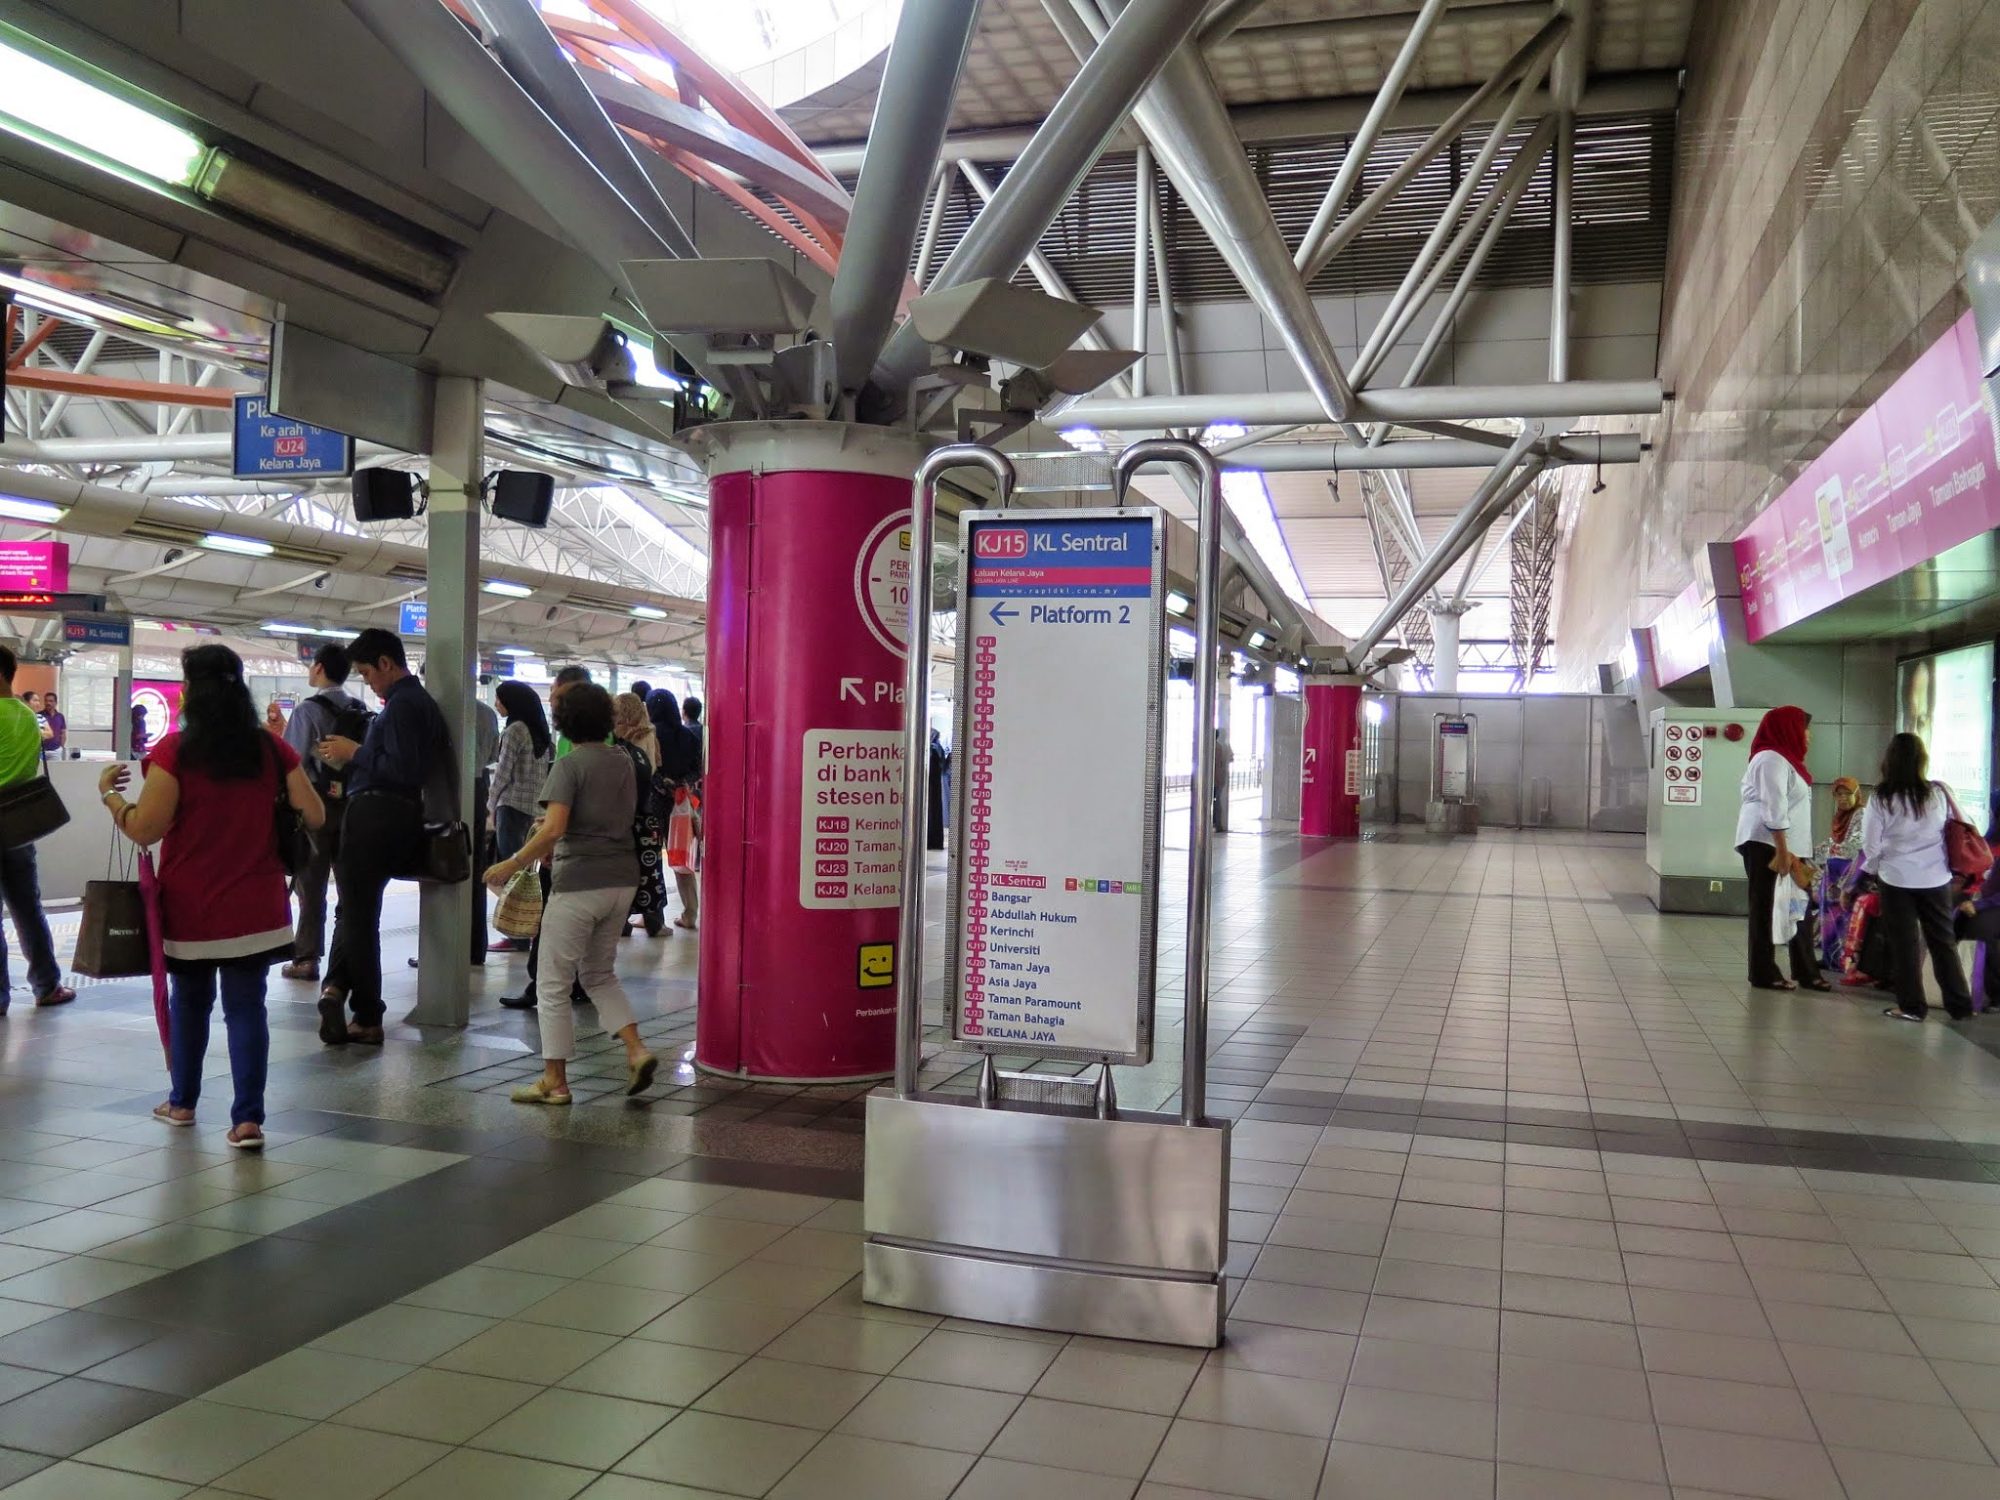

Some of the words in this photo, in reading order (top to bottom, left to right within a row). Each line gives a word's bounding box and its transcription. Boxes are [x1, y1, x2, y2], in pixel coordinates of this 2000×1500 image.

[260, 425, 276, 438] Ke
[278, 422, 304, 437] arah
[276, 440, 304, 453] KJ24
[260, 458, 294, 470] Kelana
[296, 458, 322, 470] Jaya
[978, 534, 1026, 552] KJ15
[1034, 533, 1057, 552] KL
[1061, 532, 1128, 552] Sentral
[1000, 569, 1026, 577] Kelana
[1026, 570, 1044, 578] Jaya
[890, 586, 908, 605] 10
[1000, 587, 1118, 596] www.rapidkl.com.my
[1030, 604, 1111, 624] Platform
[1118, 604, 1131, 624] 2
[817, 764, 836, 782] di
[844, 764, 891, 782] bank
[816, 787, 884, 805] stesen
[819, 821, 848, 830] KJ18
[856, 818, 902, 830] Kerinch
[818, 842, 847, 852] KJ20
[854, 840, 896, 852] Taman
[818, 864, 846, 874] KJ23
[854, 862, 896, 874] Taman
[992, 875, 1006, 884] KL
[1008, 876, 1045, 888] Sentral
[817, 886, 846, 895] KJ24
[854, 884, 896, 895] Kelana
[992, 892, 1032, 904] Bangsar
[990, 909, 1036, 921] Abdullah
[1040, 912, 1077, 923] Hukum
[990, 926, 1034, 938] Kerinchi
[990, 942, 1040, 955] Universiti
[989, 960, 1023, 971] Taman
[1026, 962, 1050, 974] Jaya
[988, 977, 1010, 987] Asia
[1013, 979, 1037, 990] Jaya
[988, 993, 1021, 1005] Taman
[1025, 996, 1081, 1010] Paramount
[856, 1008, 892, 1017] Perbankan
[987, 1010, 1021, 1022] Taman
[1024, 1013, 1065, 1027] Bahagia
[987, 1027, 1027, 1040] KELANA
[1031, 1031, 1056, 1042] JAYA
